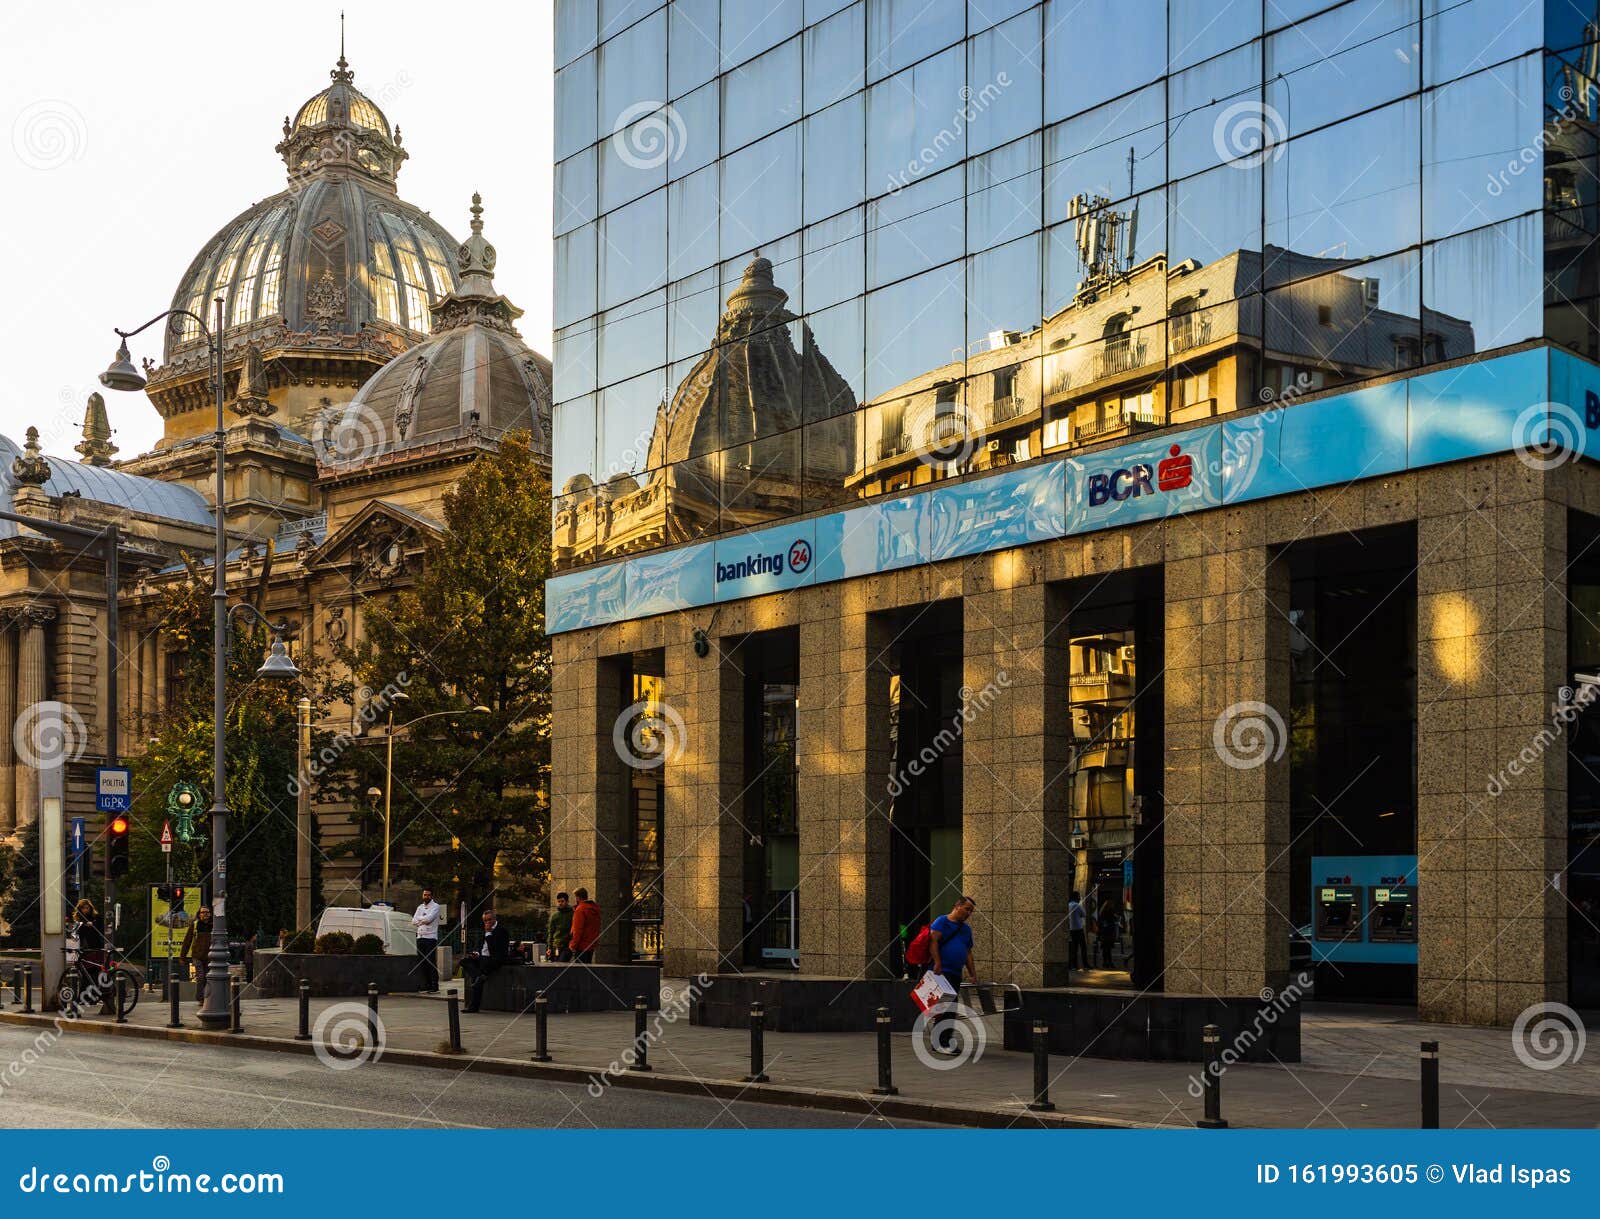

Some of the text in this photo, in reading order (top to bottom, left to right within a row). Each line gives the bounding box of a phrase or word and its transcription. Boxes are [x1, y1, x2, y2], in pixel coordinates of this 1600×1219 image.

[1089, 463, 1155, 508] BCR
[716, 548, 808, 583] banking 24
